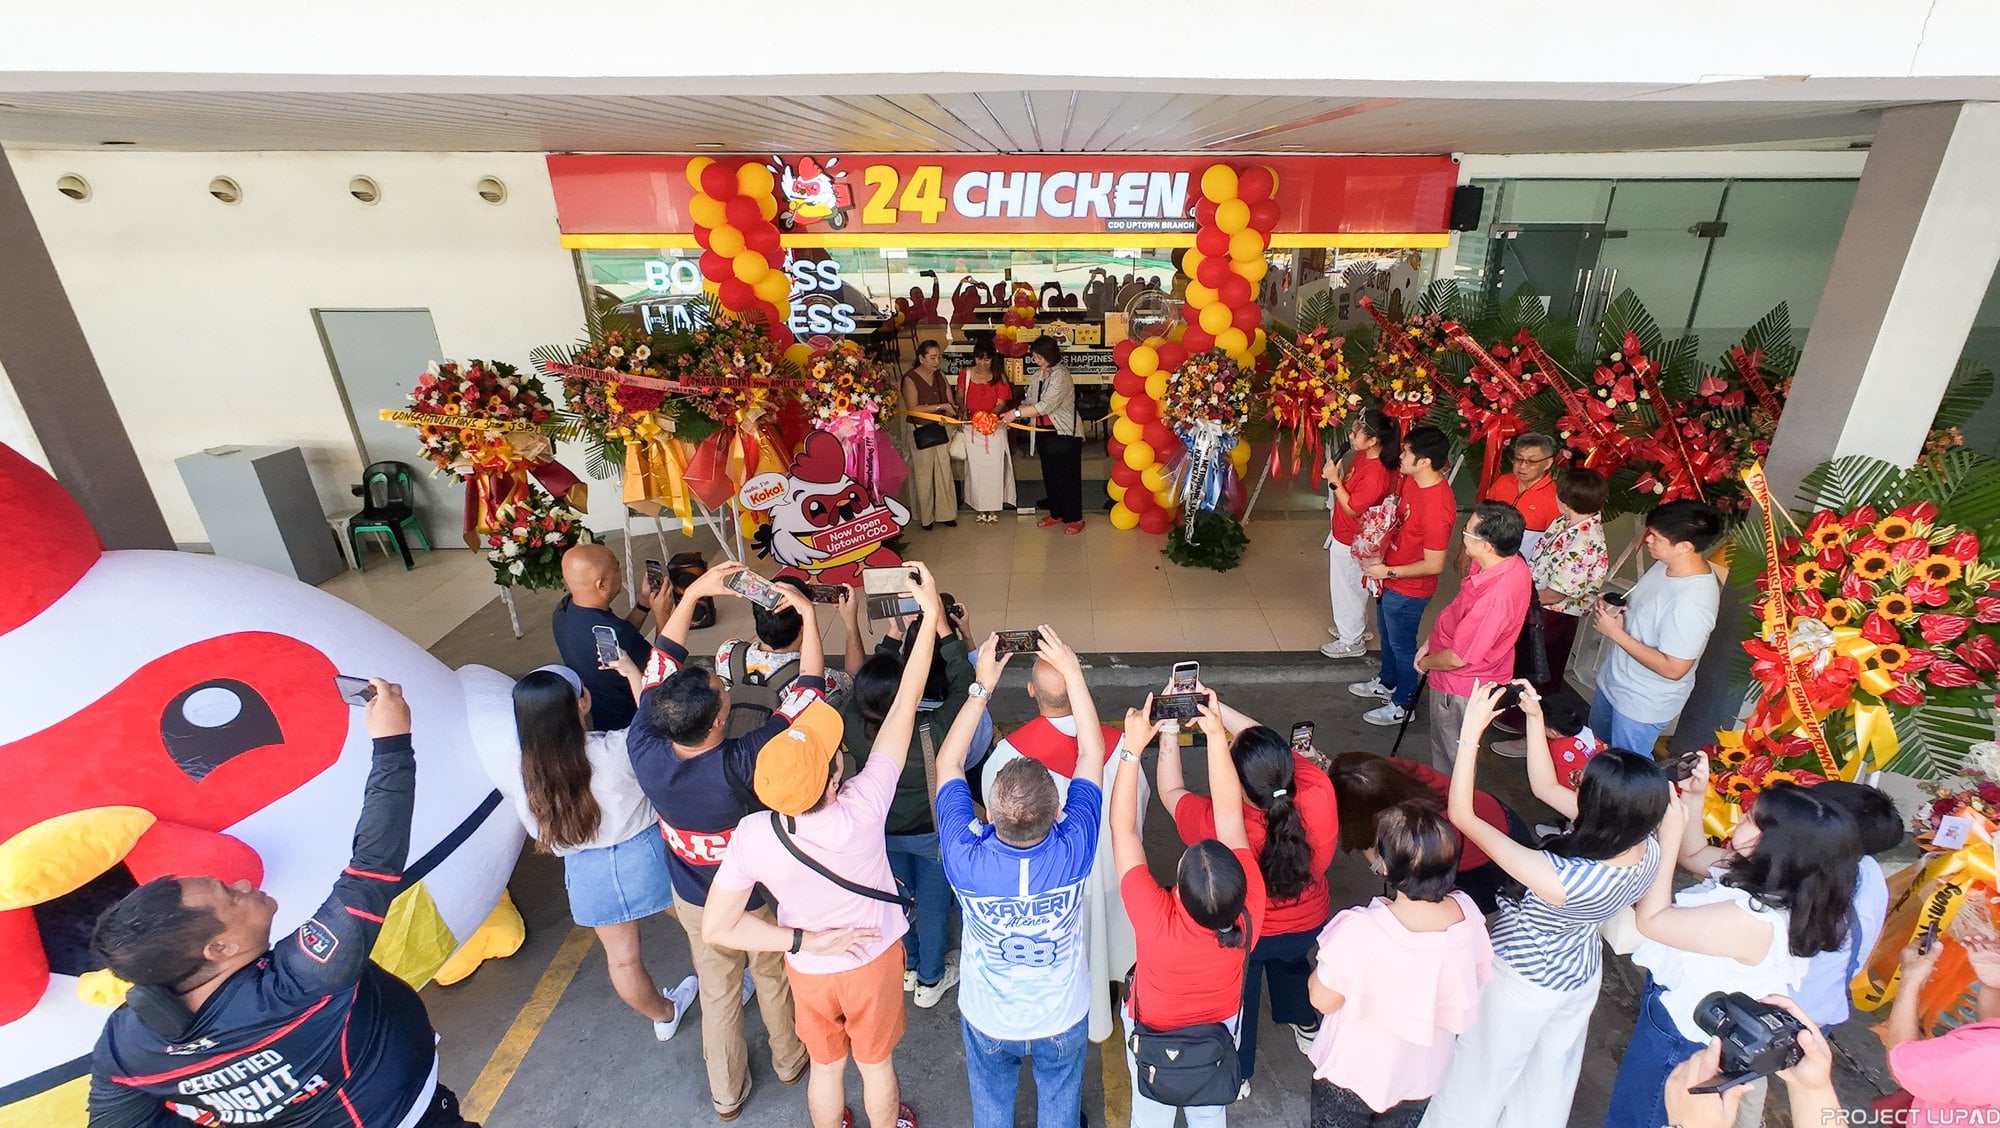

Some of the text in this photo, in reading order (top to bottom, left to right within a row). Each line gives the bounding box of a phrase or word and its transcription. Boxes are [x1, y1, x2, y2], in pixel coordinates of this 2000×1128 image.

[862, 164, 1190, 224] 24 CHICKEN
[1108, 221, 1195, 229] CDO UPTOWN BRANCH
[1070, 354, 1114, 364] HAPPINES
[391, 411, 477, 428] CONGRATULATIONS
[750, 481, 784, 505] Koko!
[826, 524, 888, 553] Uptown CDO
[829, 517, 881, 542] Now Open
[1791, 686, 1815, 719] BANK
[1806, 721, 1836, 770] UPTOWN
[177, 1049, 284, 1095] CERTIFIED
[197, 1063, 300, 1112] NIGHT
